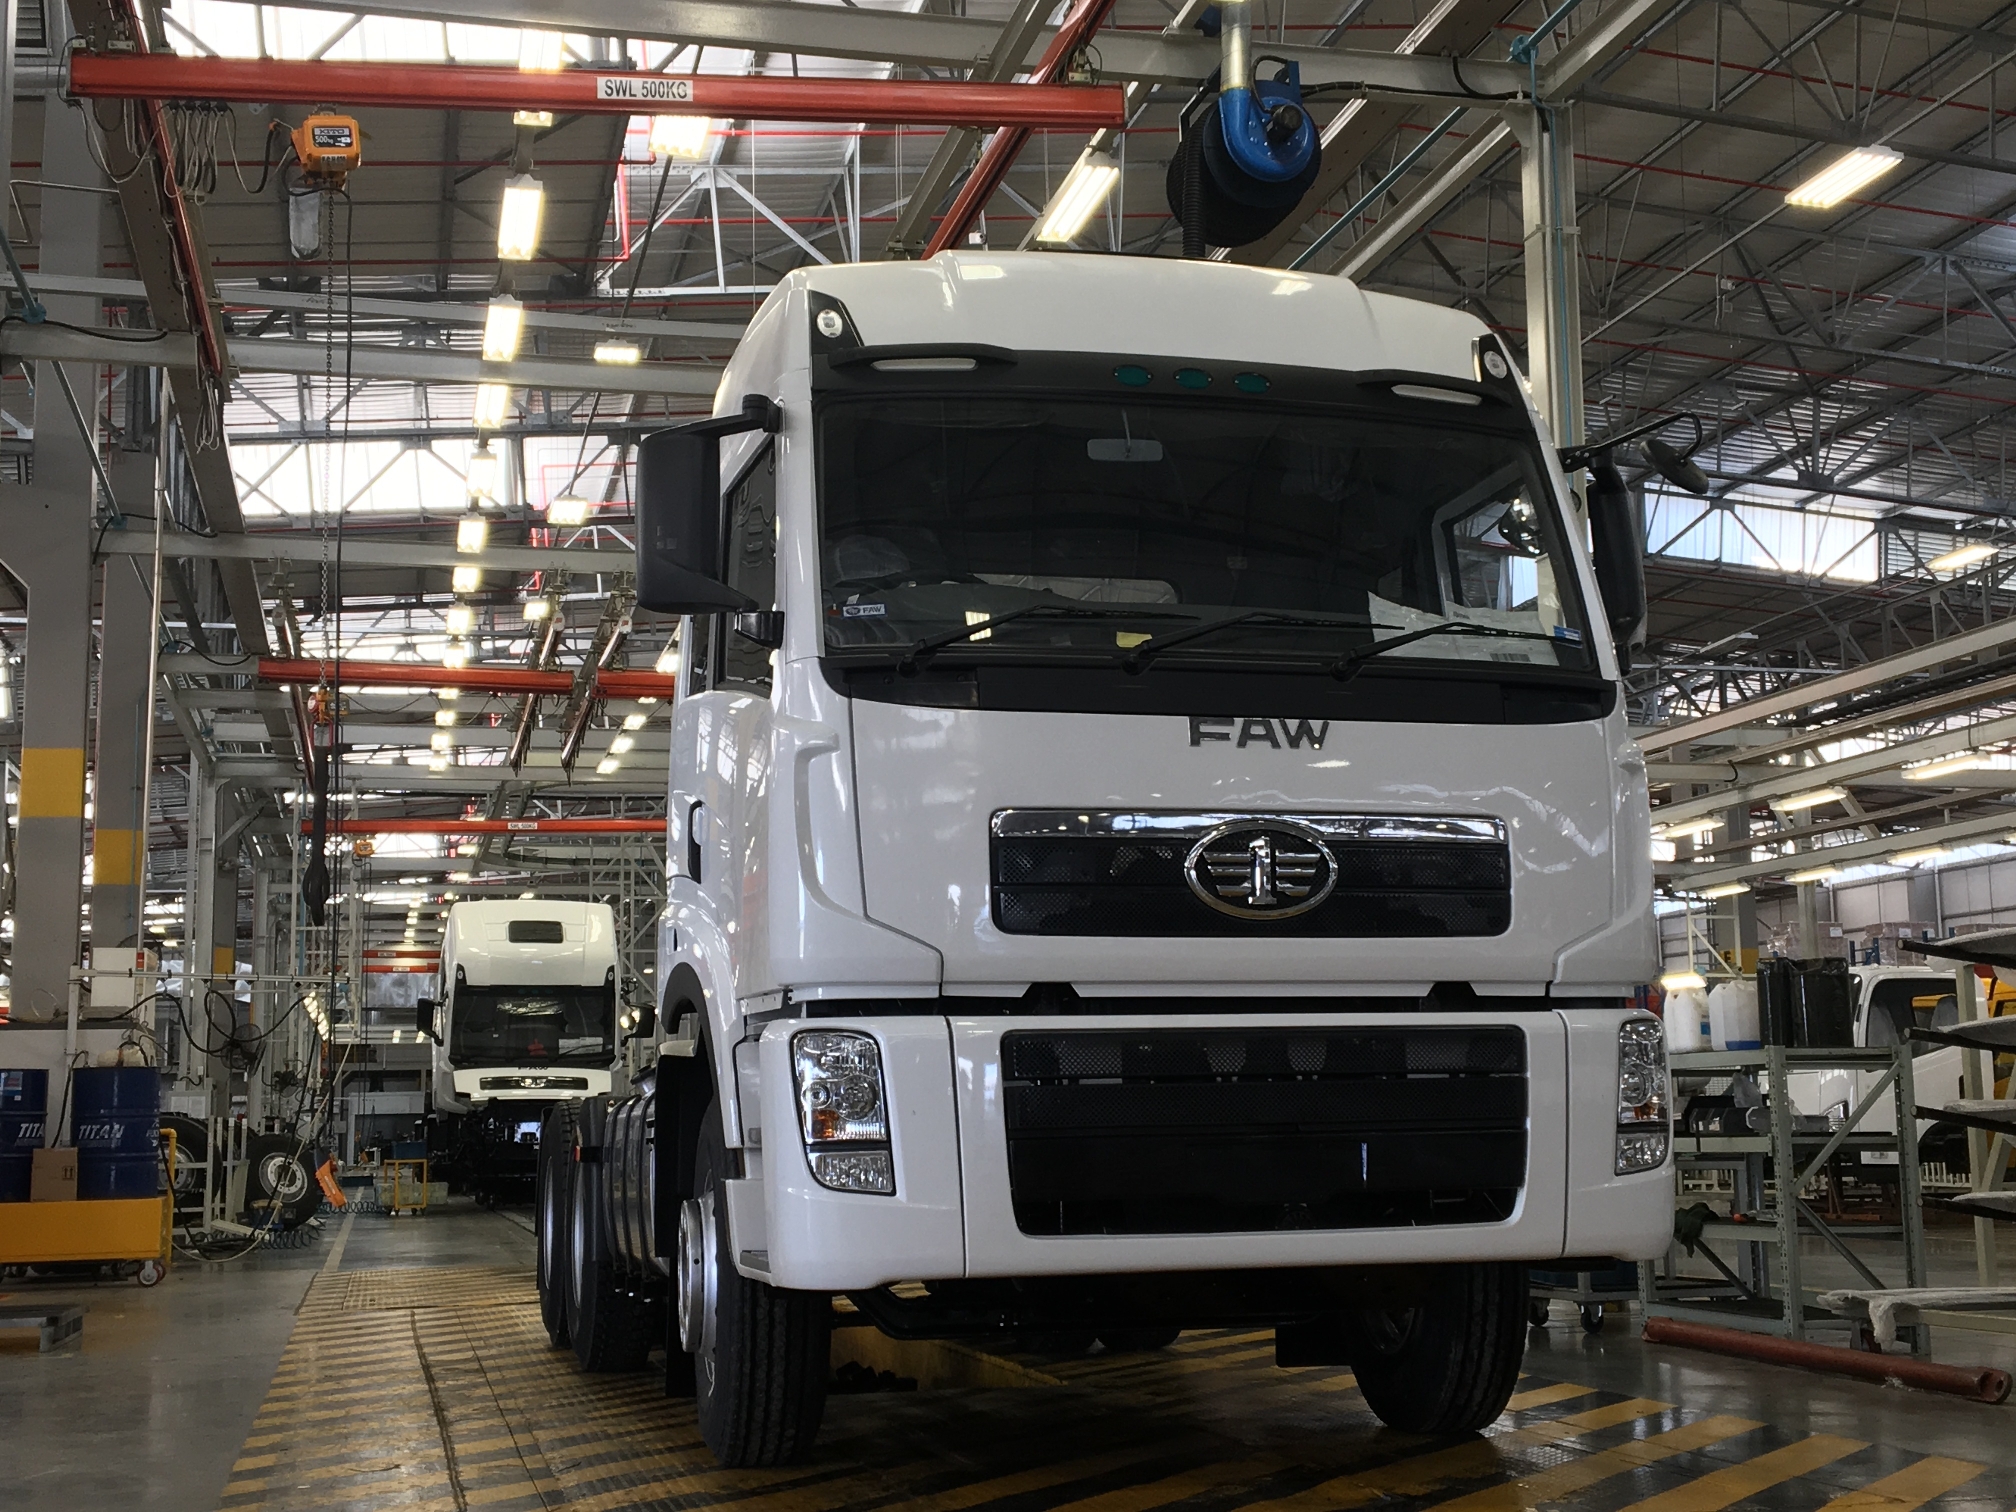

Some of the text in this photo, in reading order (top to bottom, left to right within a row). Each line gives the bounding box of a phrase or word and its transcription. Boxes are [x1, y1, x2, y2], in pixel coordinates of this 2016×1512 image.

[604, 79, 688, 99] SWL 500KG
[862, 605, 882, 613] FAW
[1189, 716, 1330, 750] FAW
[79, 1122, 125, 1139] TITAN
